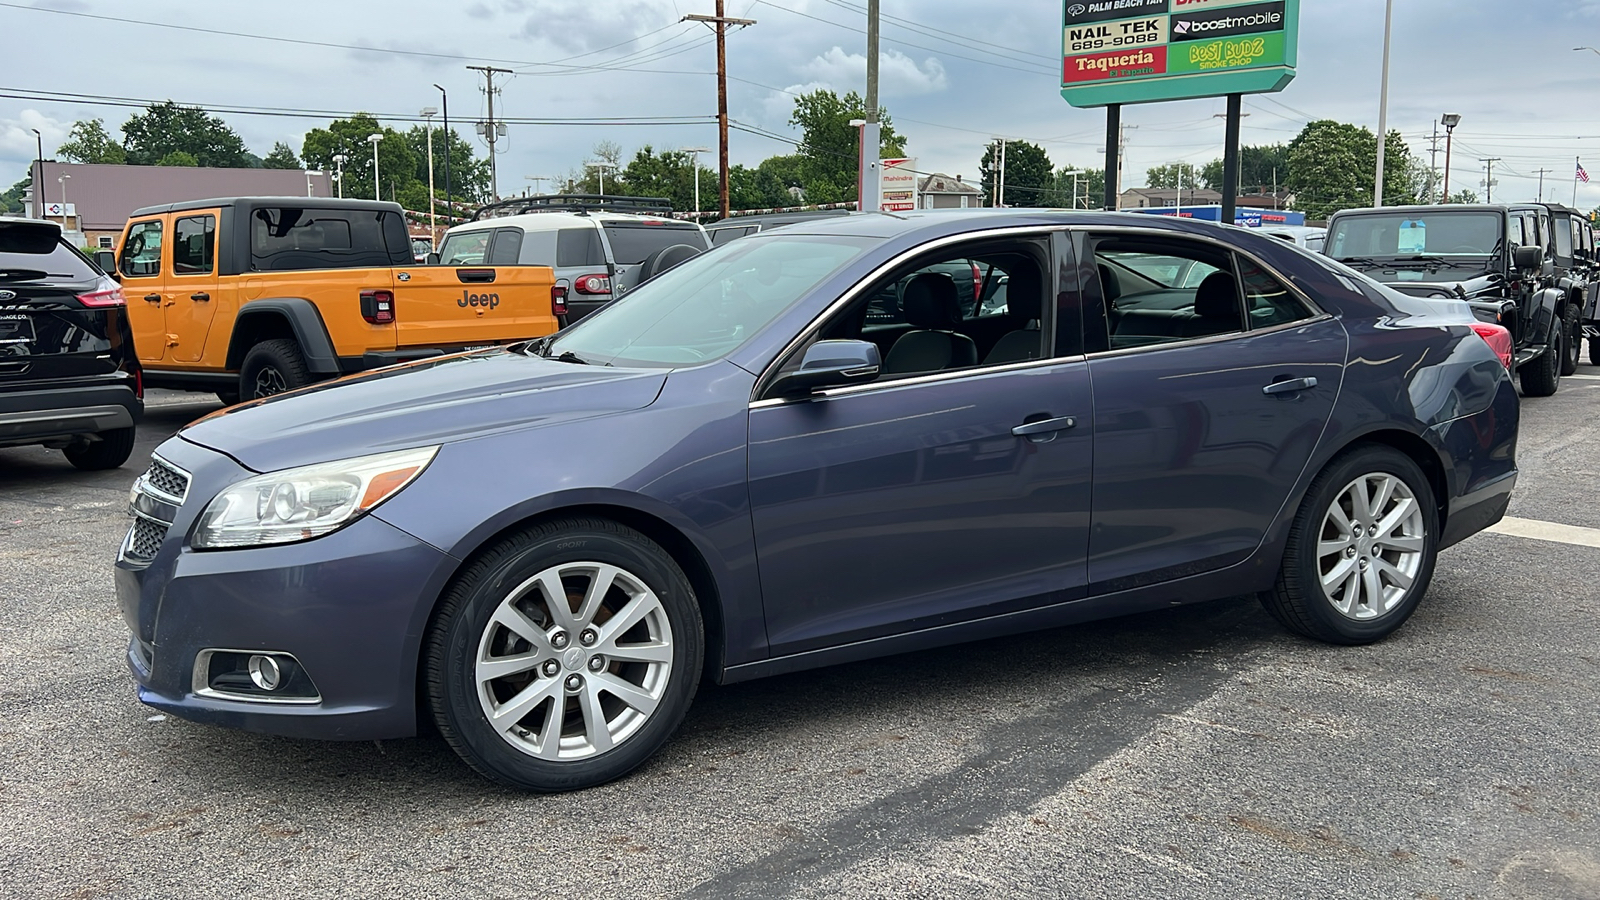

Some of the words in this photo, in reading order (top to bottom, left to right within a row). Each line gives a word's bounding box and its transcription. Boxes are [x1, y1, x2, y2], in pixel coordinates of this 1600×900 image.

[1088, 2, 1112, 13] PALM
[1113, 0, 1143, 9] BEACH
[1070, 26, 1111, 40] NAIL
[1120, 19, 1159, 34] TEK
[1072, 32, 1158, 51] 689-9088
[1199, 59, 1228, 70] SMOKE
[1228, 57, 1252, 68] SHOP
[457, 290, 499, 309] Jeep
[556, 540, 588, 551] SPORT
